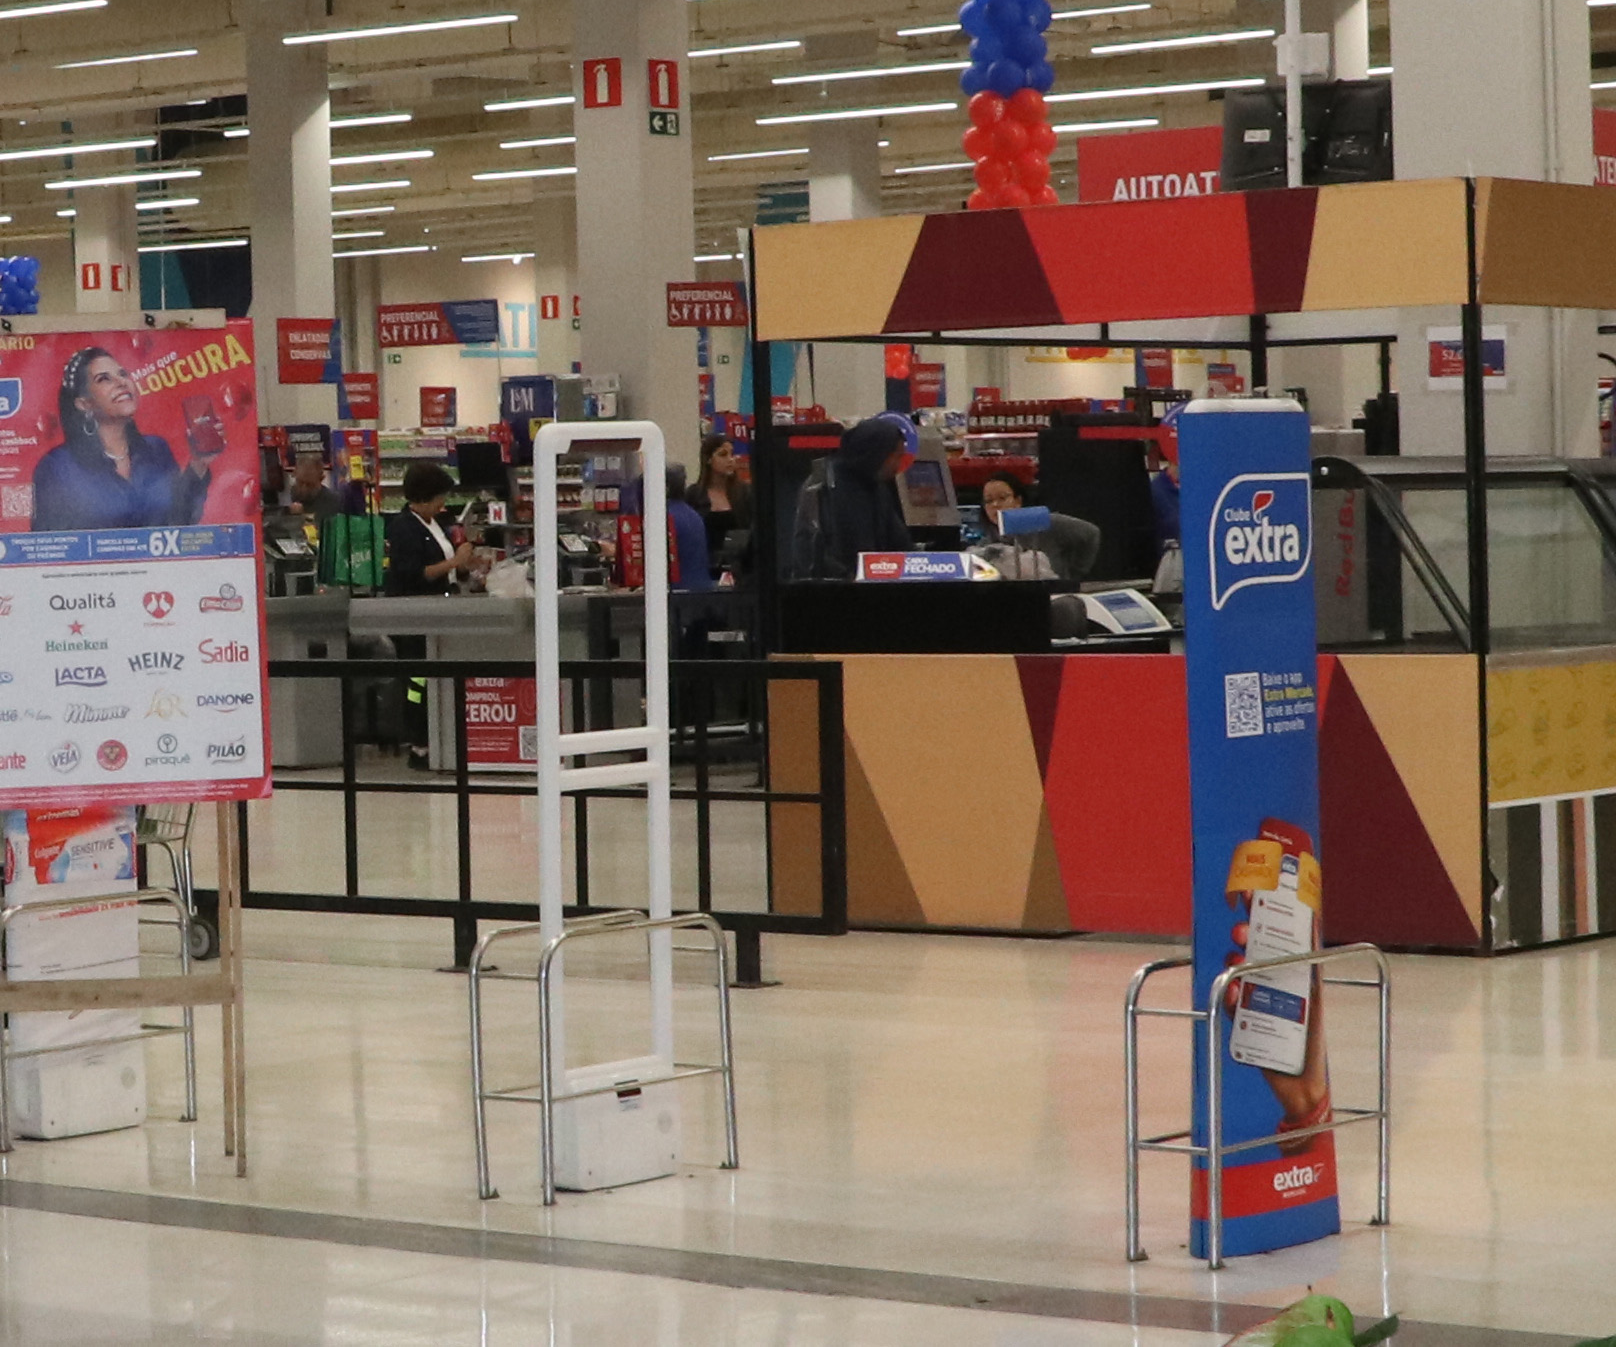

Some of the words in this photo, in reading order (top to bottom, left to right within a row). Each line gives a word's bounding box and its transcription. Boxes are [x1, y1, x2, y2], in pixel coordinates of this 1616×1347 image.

[670, 290, 734, 301] PREFERENCIAL
[380, 311, 439, 323] PREFERENCIAL
[131, 362, 156, 381] Mais
[156, 351, 177, 369] que
[135, 334, 252, 396] LOUCURA
[1224, 509, 1251, 522] Clube
[149, 530, 180, 556] 6X
[1225, 516, 1300, 565] extra
[870, 561, 898, 571] extra
[904, 563, 957, 574] FECHADO
[49, 592, 116, 611] Qualitá
[45, 639, 108, 652] Heineken
[198, 638, 249, 664] Sadia
[128, 652, 184, 673] HEINZ
[55, 666, 108, 687] LACTA
[1263, 673, 1282, 686] Baixe
[1289, 673, 1303, 686] app
[1264, 689, 1284, 701] Extra
[71, 838, 115, 855] SENSITIVE
[1274, 1165, 1314, 1192] extra
